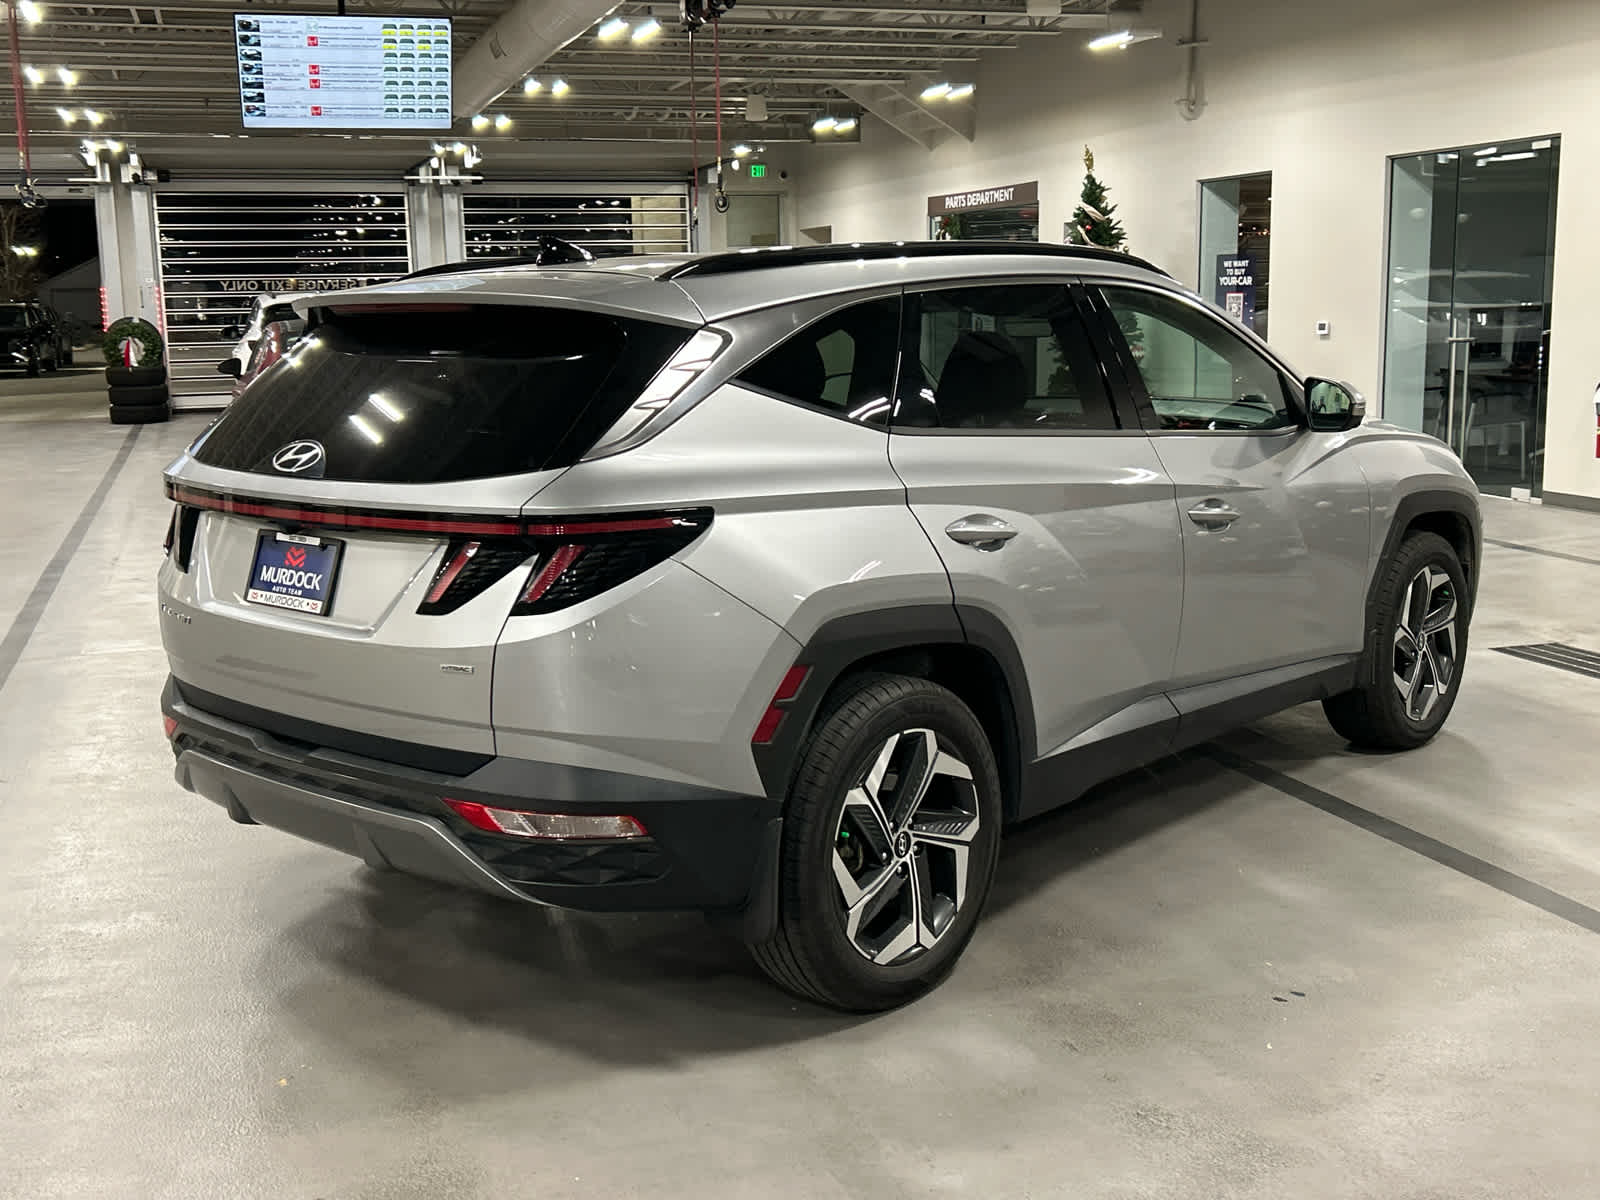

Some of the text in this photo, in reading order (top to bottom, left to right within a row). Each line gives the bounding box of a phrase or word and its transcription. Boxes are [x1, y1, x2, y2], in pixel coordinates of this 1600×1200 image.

[944, 187, 1014, 209] PARTS DEPARTMENT
[1223, 260, 1249, 268] WE WANT
[1219, 276, 1253, 286] YOUR CAR
[260, 565, 323, 591] MURDOCK
[271, 585, 303, 596] AUTO TEAM
[263, 593, 305, 609] MURDOCK
